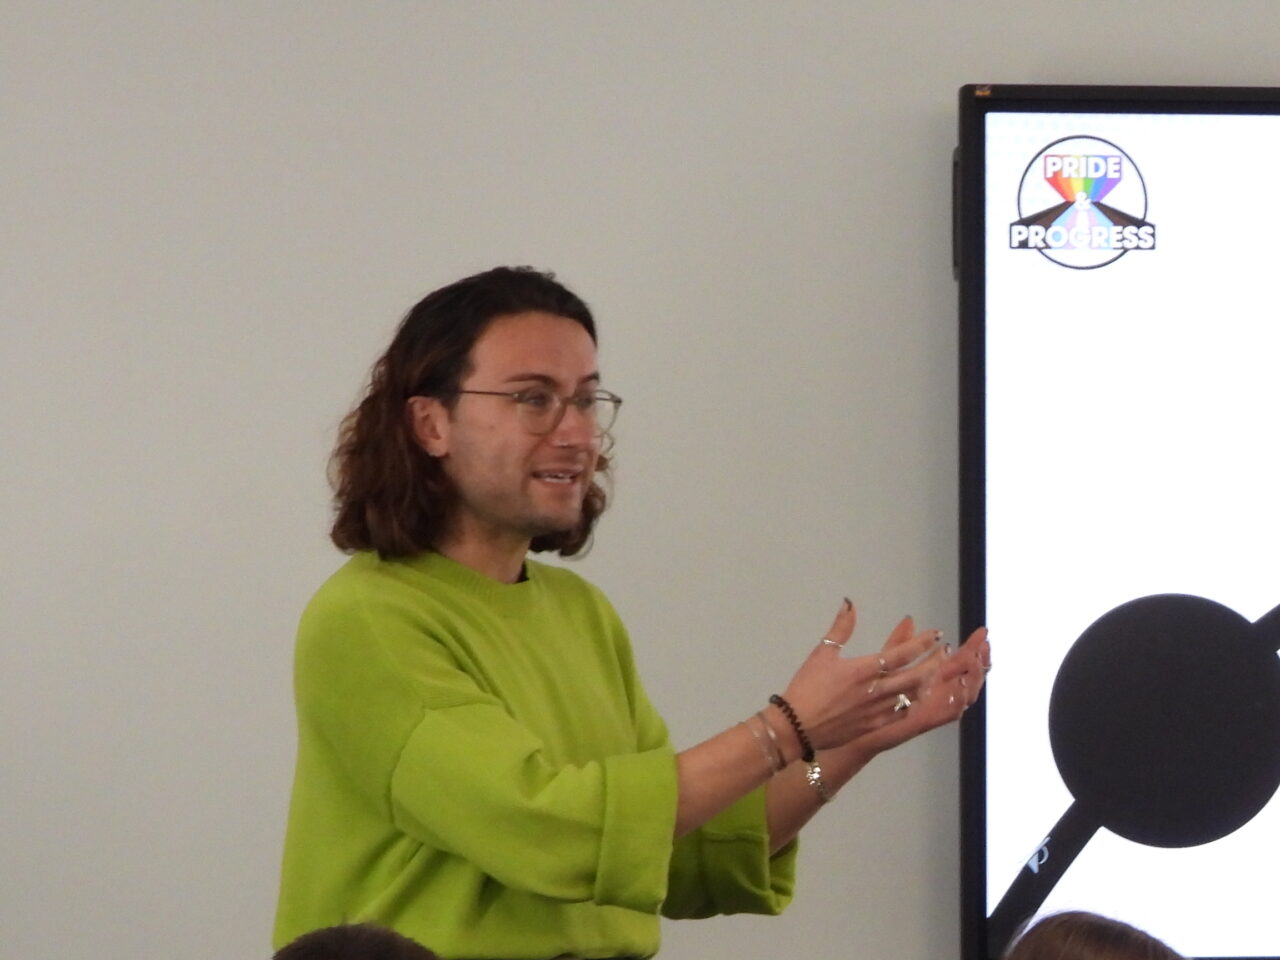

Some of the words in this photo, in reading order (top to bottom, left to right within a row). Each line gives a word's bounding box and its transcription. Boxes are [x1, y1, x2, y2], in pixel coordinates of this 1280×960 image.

[1045, 156, 1121, 179] PRIDE
[1074, 191, 1091, 210] &
[1010, 225, 1155, 249] PROGRESS
